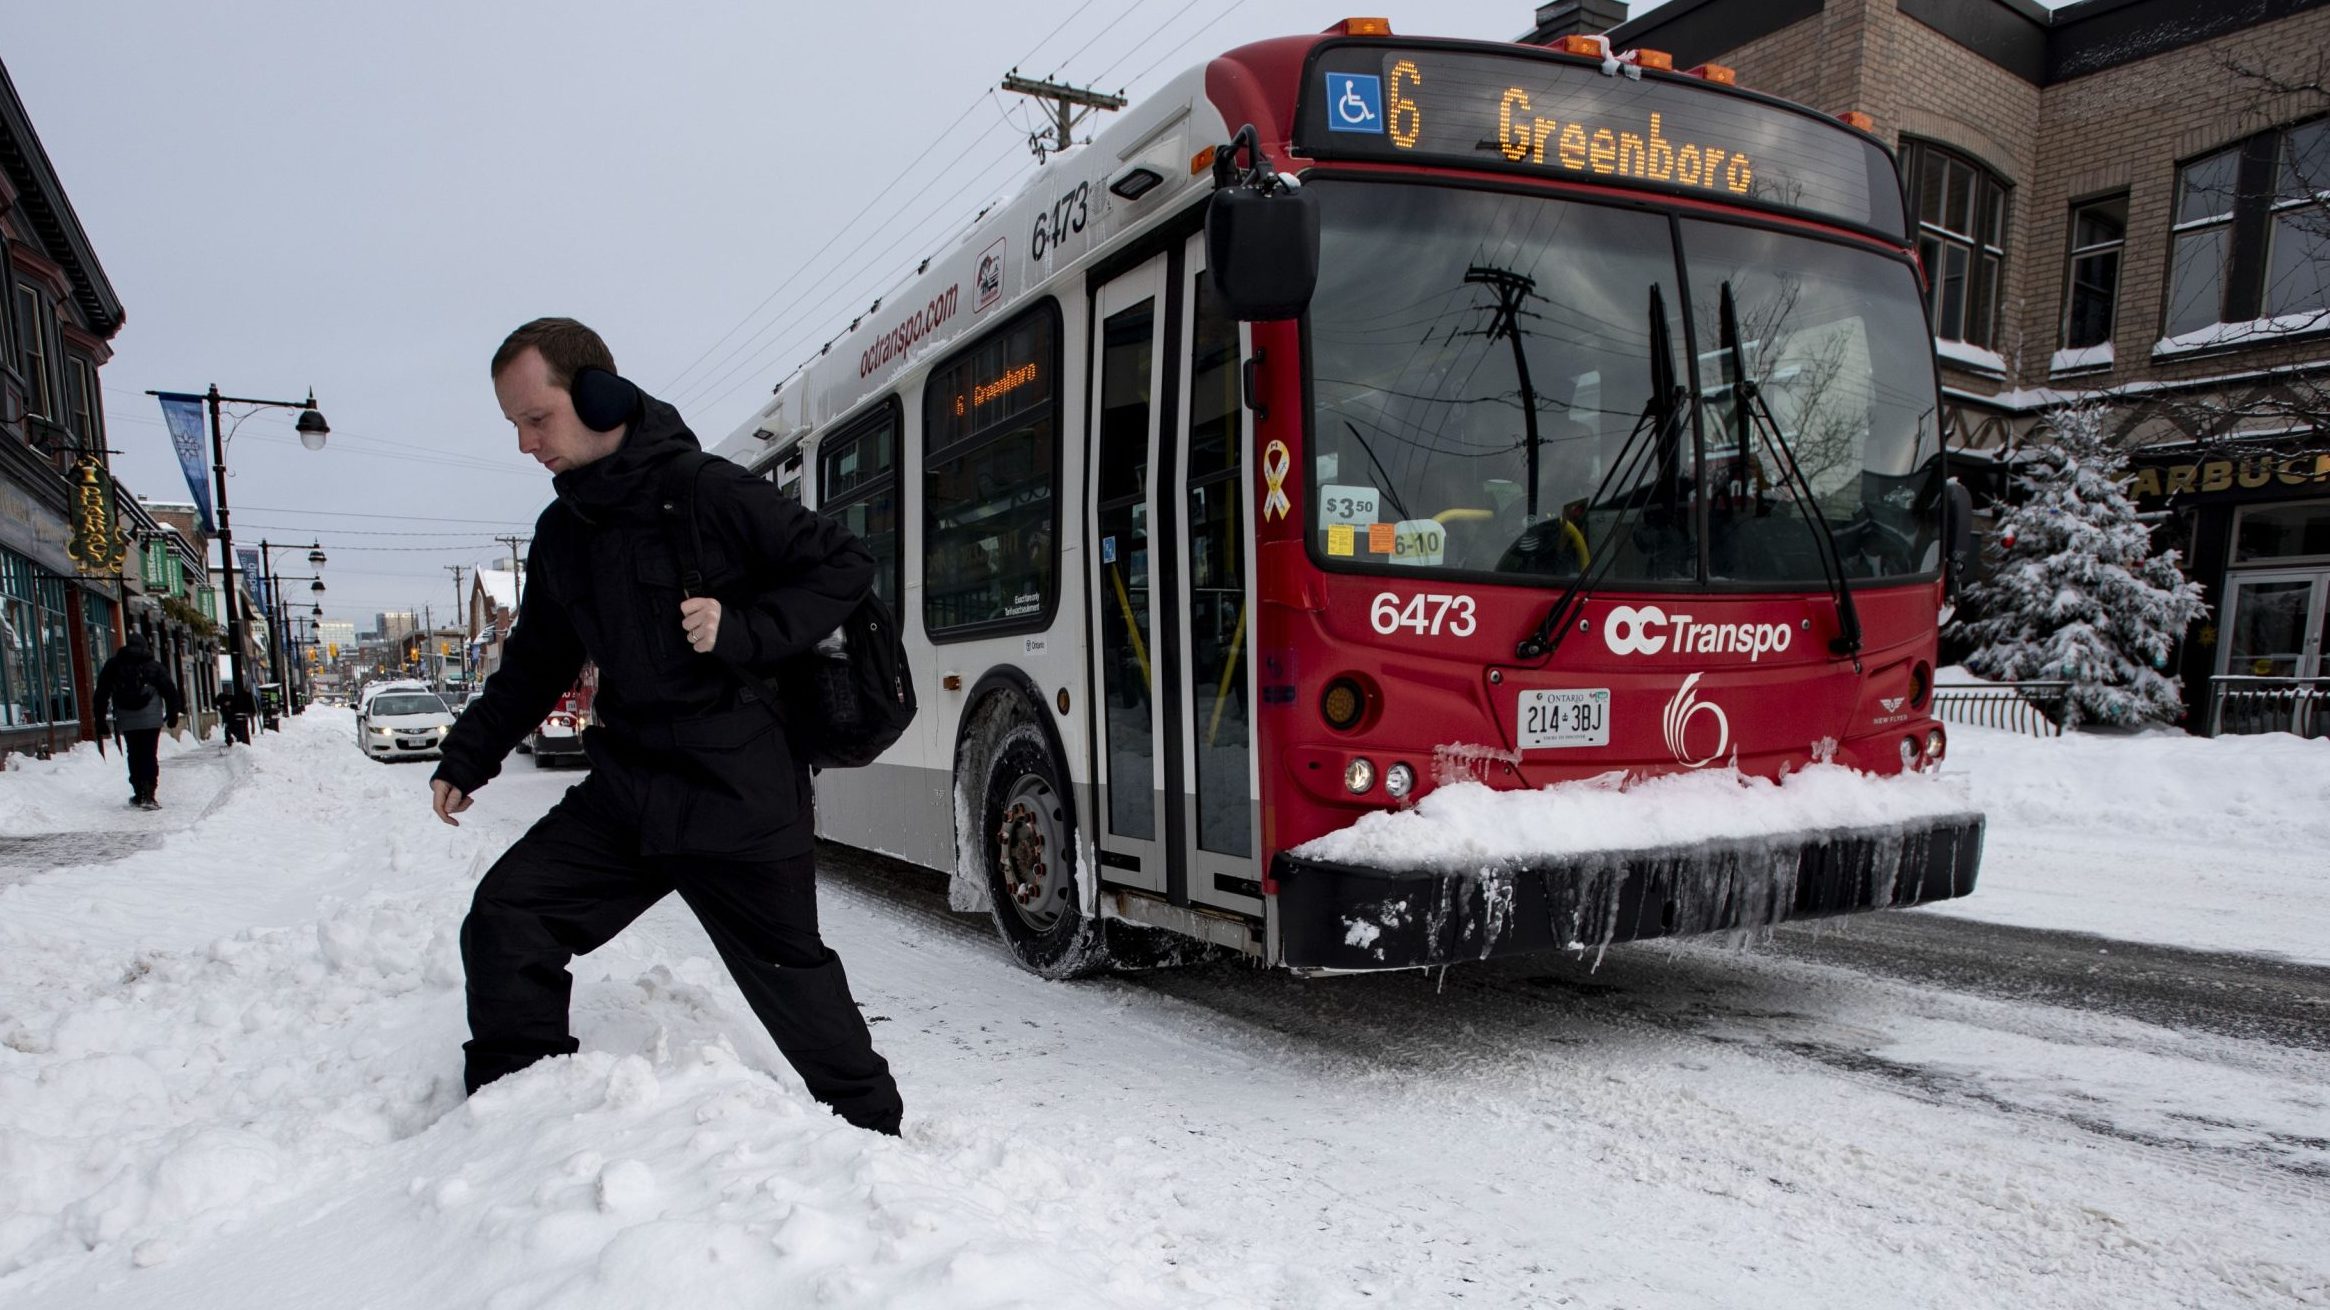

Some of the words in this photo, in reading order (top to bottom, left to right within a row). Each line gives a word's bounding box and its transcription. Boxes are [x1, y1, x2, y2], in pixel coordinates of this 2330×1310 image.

[1388, 58, 1421, 149] 6
[1498, 86, 1752, 195] Greenboro
[1031, 180, 1090, 262] 6473
[860, 282, 960, 379] octranspo.com
[2110, 454, 2330, 500] ARBUC
[1394, 532, 1439, 556] 6-10
[1370, 592, 1477, 637] 6473
[1670, 615, 1792, 662] Transpo
[1547, 693, 1584, 704] ONTARIO
[1873, 717, 1889, 725] NEW
[1890, 714, 1908, 723] FLYER
